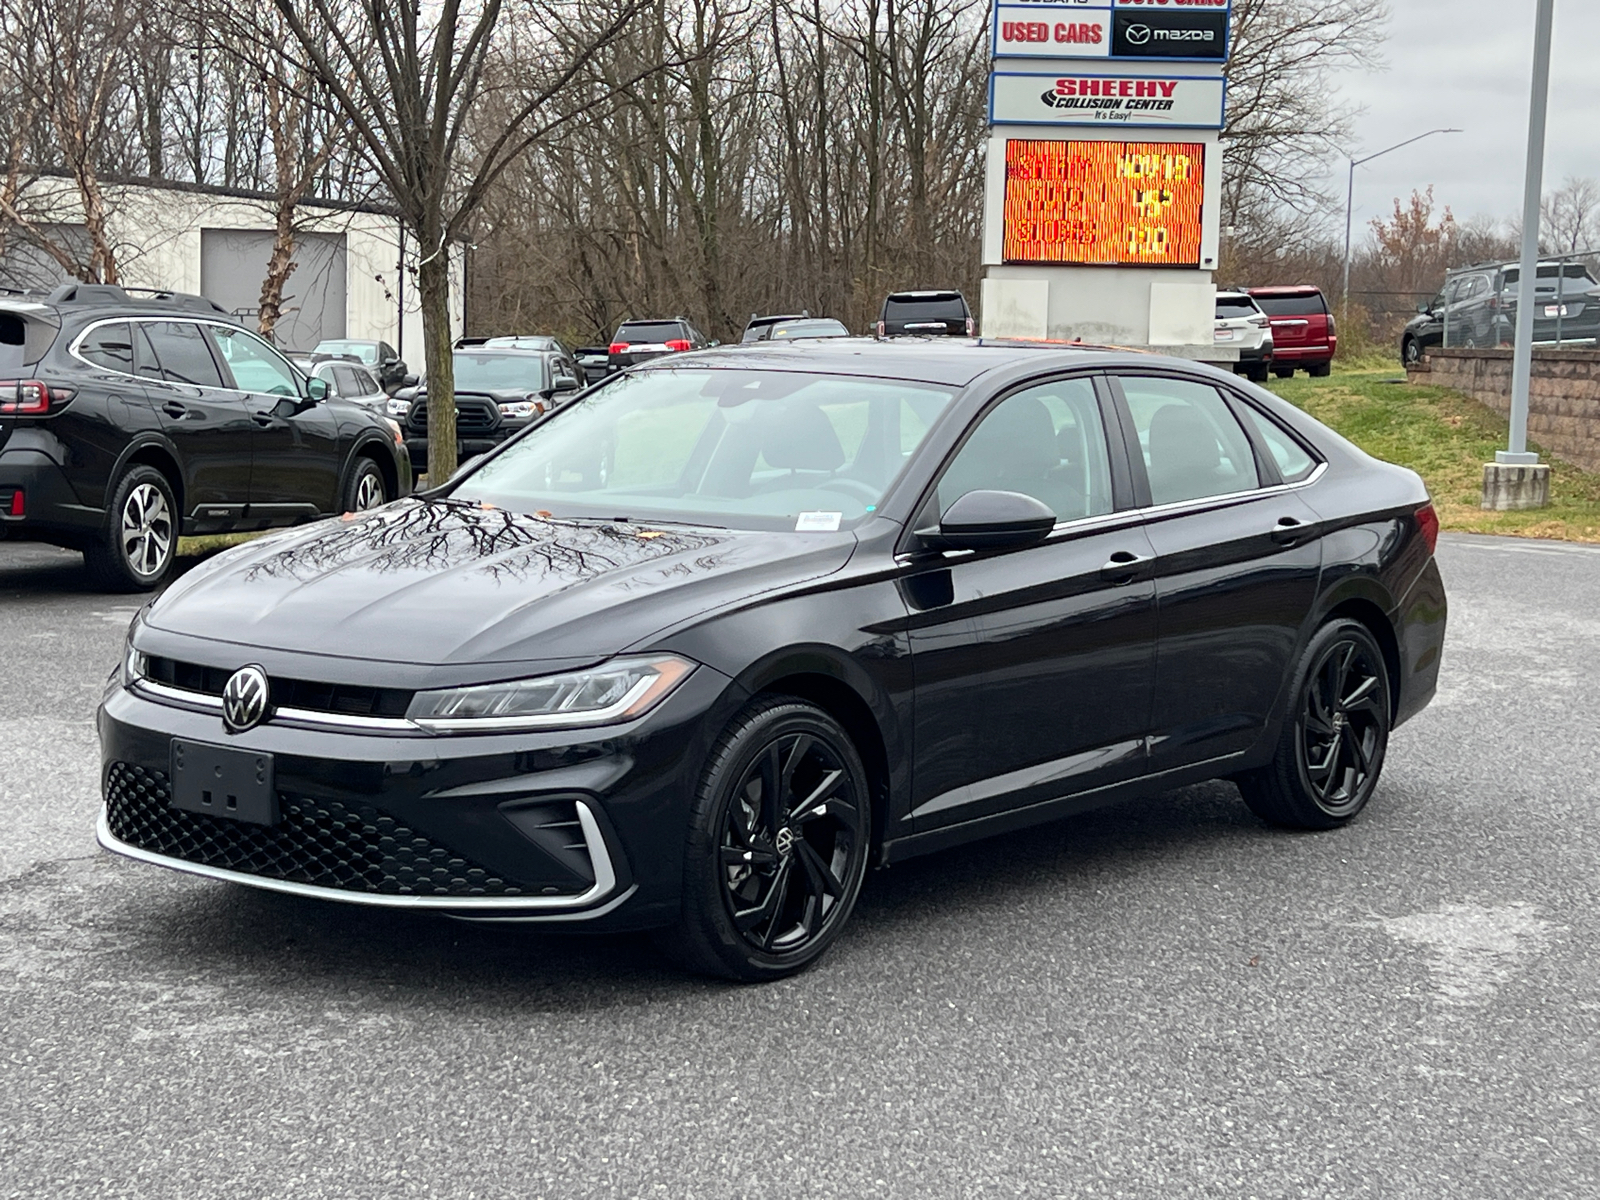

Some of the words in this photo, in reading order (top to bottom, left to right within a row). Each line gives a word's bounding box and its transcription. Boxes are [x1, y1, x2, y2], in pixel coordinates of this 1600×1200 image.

[1002, 21, 1049, 42] USED
[1054, 22, 1102, 44] CARS
[1153, 29, 1215, 41] mazda
[1055, 78, 1179, 98] SHEEHY
[1055, 97, 1123, 110] COLLISION
[1124, 99, 1175, 111] CENTER
[1108, 111, 1132, 121] Easy!
